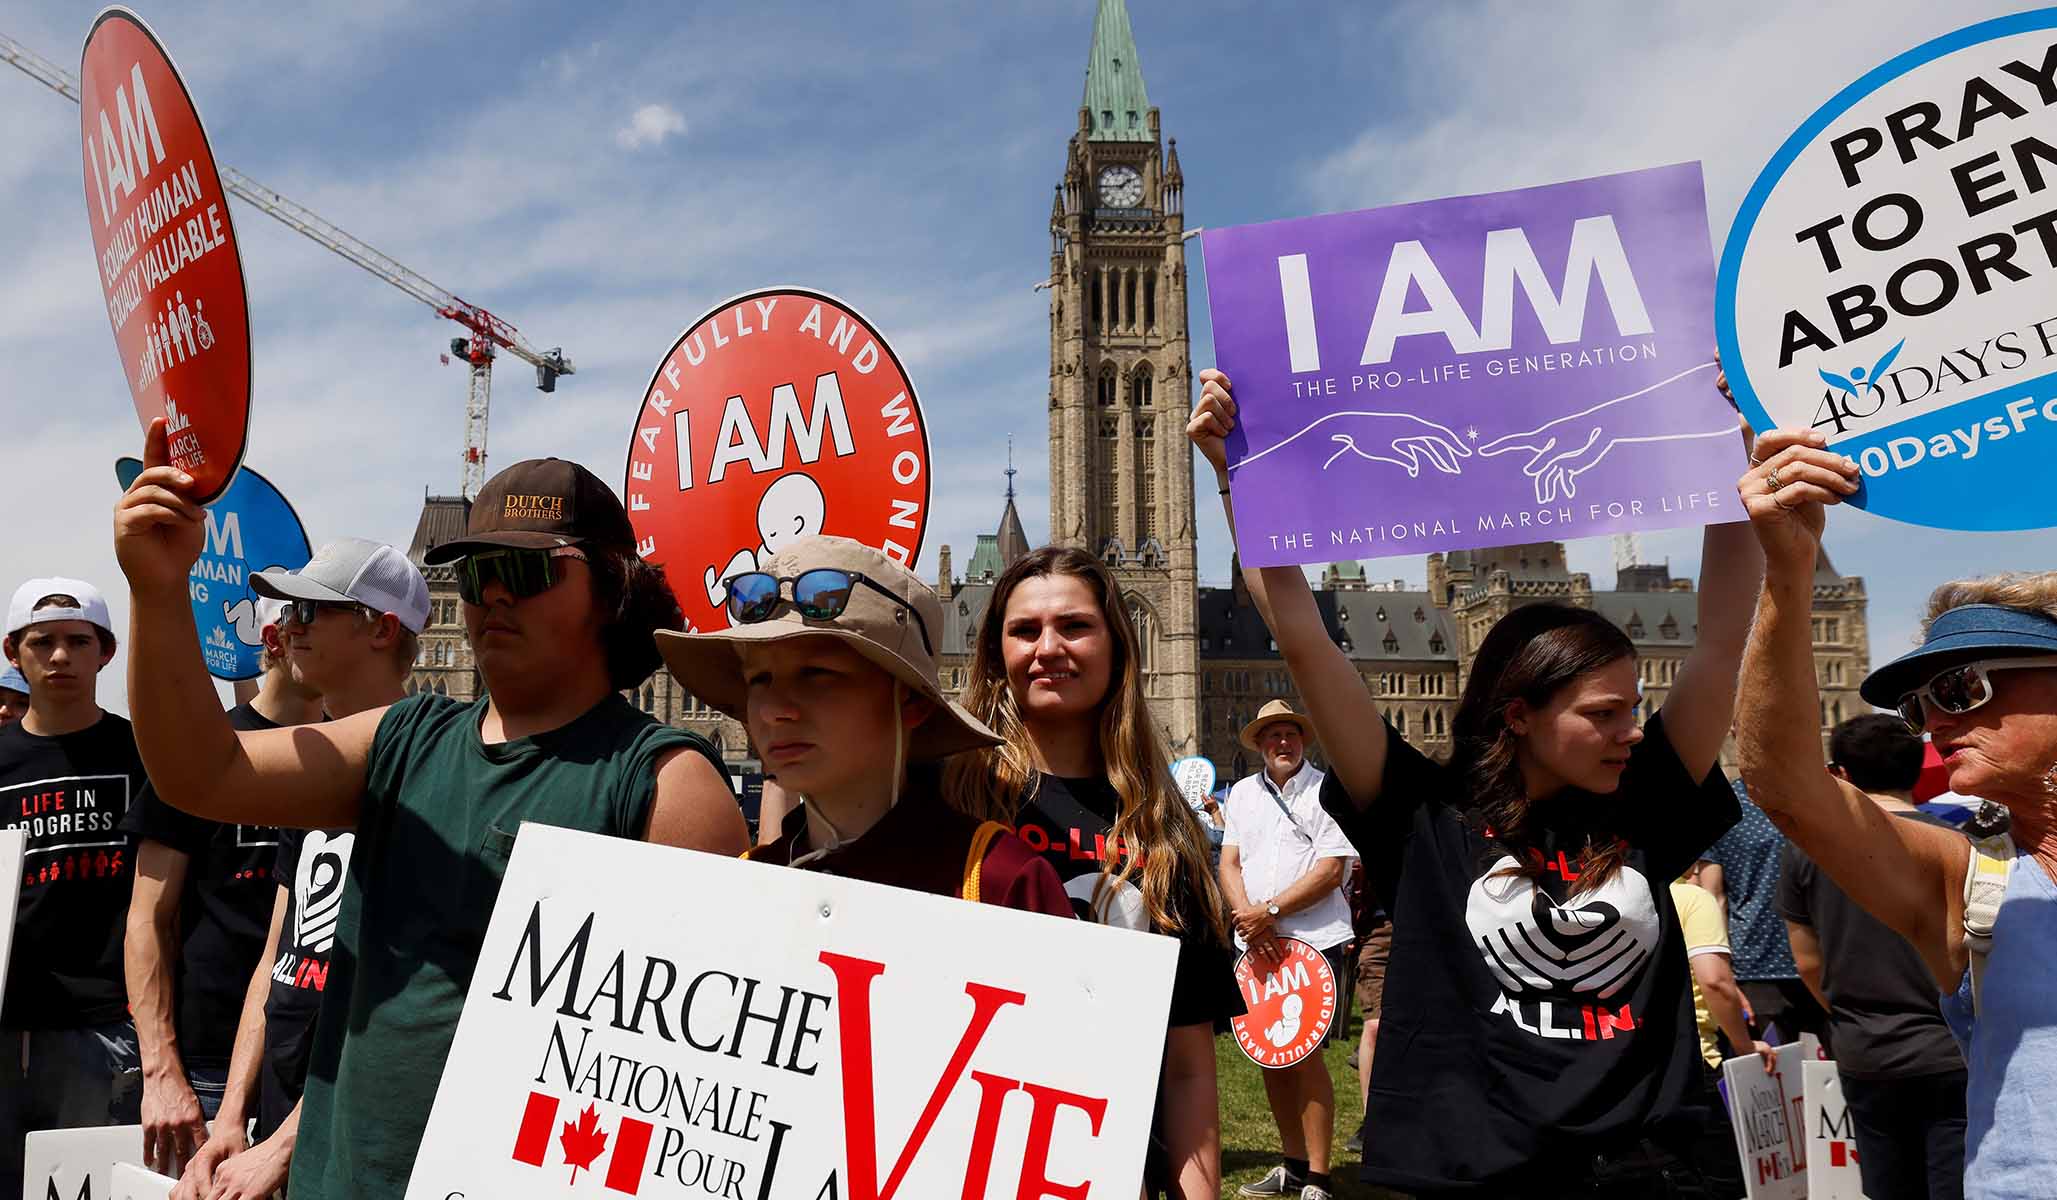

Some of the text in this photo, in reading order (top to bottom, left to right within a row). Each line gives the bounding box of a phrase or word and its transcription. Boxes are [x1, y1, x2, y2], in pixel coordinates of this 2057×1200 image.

[87, 60, 166, 227] I AM
[1830, 43, 2057, 188] PRAY
[103, 159, 203, 288] EQUALLY HUMAN
[139, 203, 226, 292] VALUABLE
[1795, 193, 1924, 273] TO
[1278, 215, 1655, 374] I AM
[1292, 342, 1658, 398] THE PRO-LIFE GENERATION
[1810, 382, 1885, 435] 40
[1885, 331, 2027, 407] DAYS
[185, 450, 206, 469] LIFE
[631, 299, 920, 564] FEARFULLY AND WOND
[673, 371, 856, 492] I AM
[202, 508, 245, 559] M
[503, 508, 563, 520] BROTHERS
[504, 494, 564, 510] DUTCH
[1269, 491, 1721, 551] THE NATIONAL MARCH FOR LIFE
[205, 647, 238, 664] MARCH
[206, 656, 238, 673] FOR LIFE
[22, 789, 96, 817] LIFE IN
[492, 900, 832, 1076] MARCHE
[1248, 978, 1259, 1005] I
[1264, 961, 1311, 1001] AM
[1286, 941, 1316, 961] AND
[1236, 1021, 1266, 1060] MADE
[1270, 964, 1333, 1065] WONDERFULLY
[534, 1019, 768, 1142] NATIONALE
[818, 950, 1108, 1200] VIE
[653, 1126, 746, 1200] POUR
